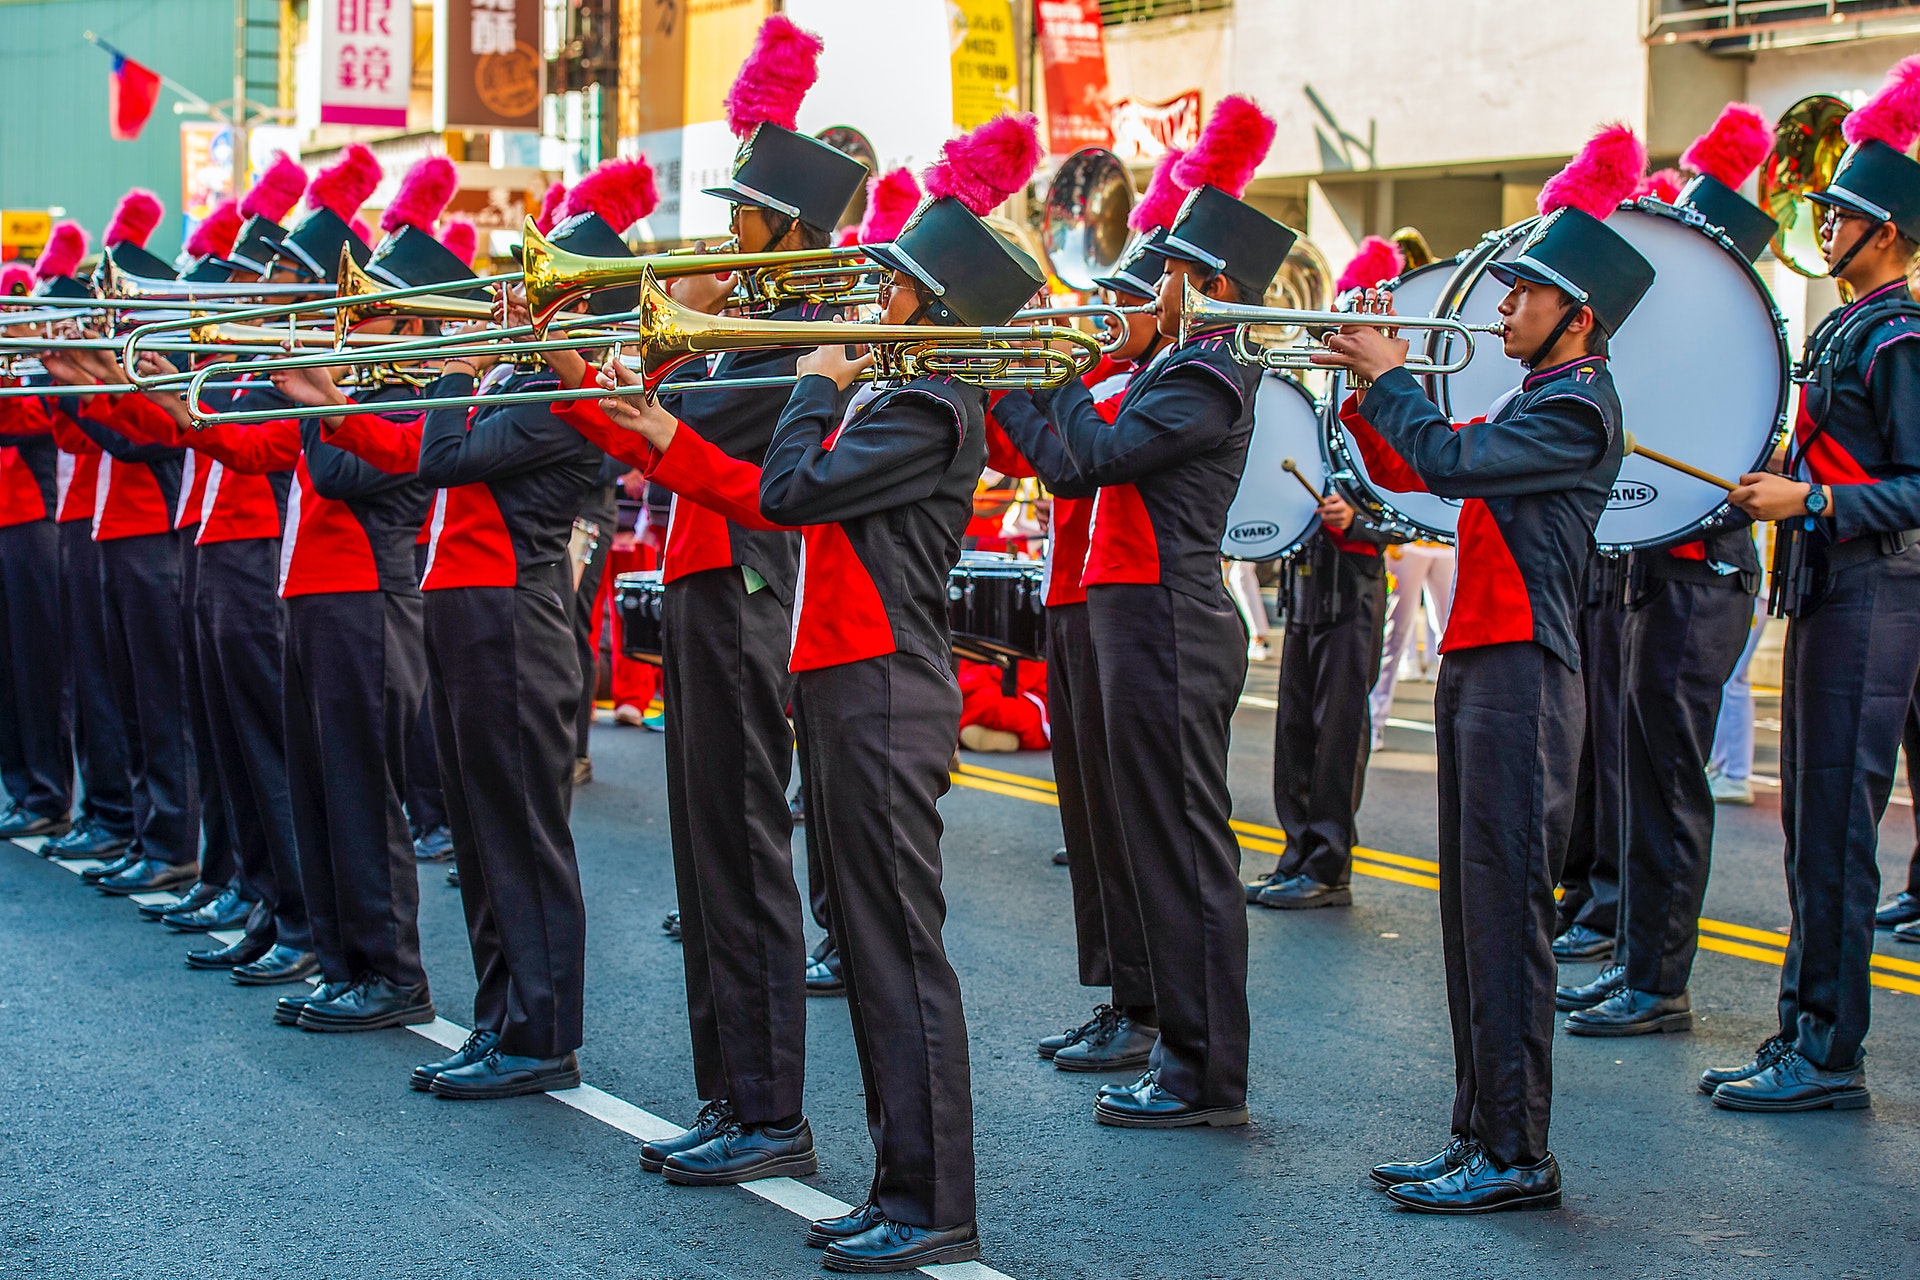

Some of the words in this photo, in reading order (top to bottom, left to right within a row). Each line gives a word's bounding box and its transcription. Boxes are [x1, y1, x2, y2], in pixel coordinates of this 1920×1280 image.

[471, 0, 517, 55] 酥
[338, 0, 391, 92] 眼鏡
[1608, 488, 1648, 501] ANS
[1234, 526, 1273, 539] EVANS
